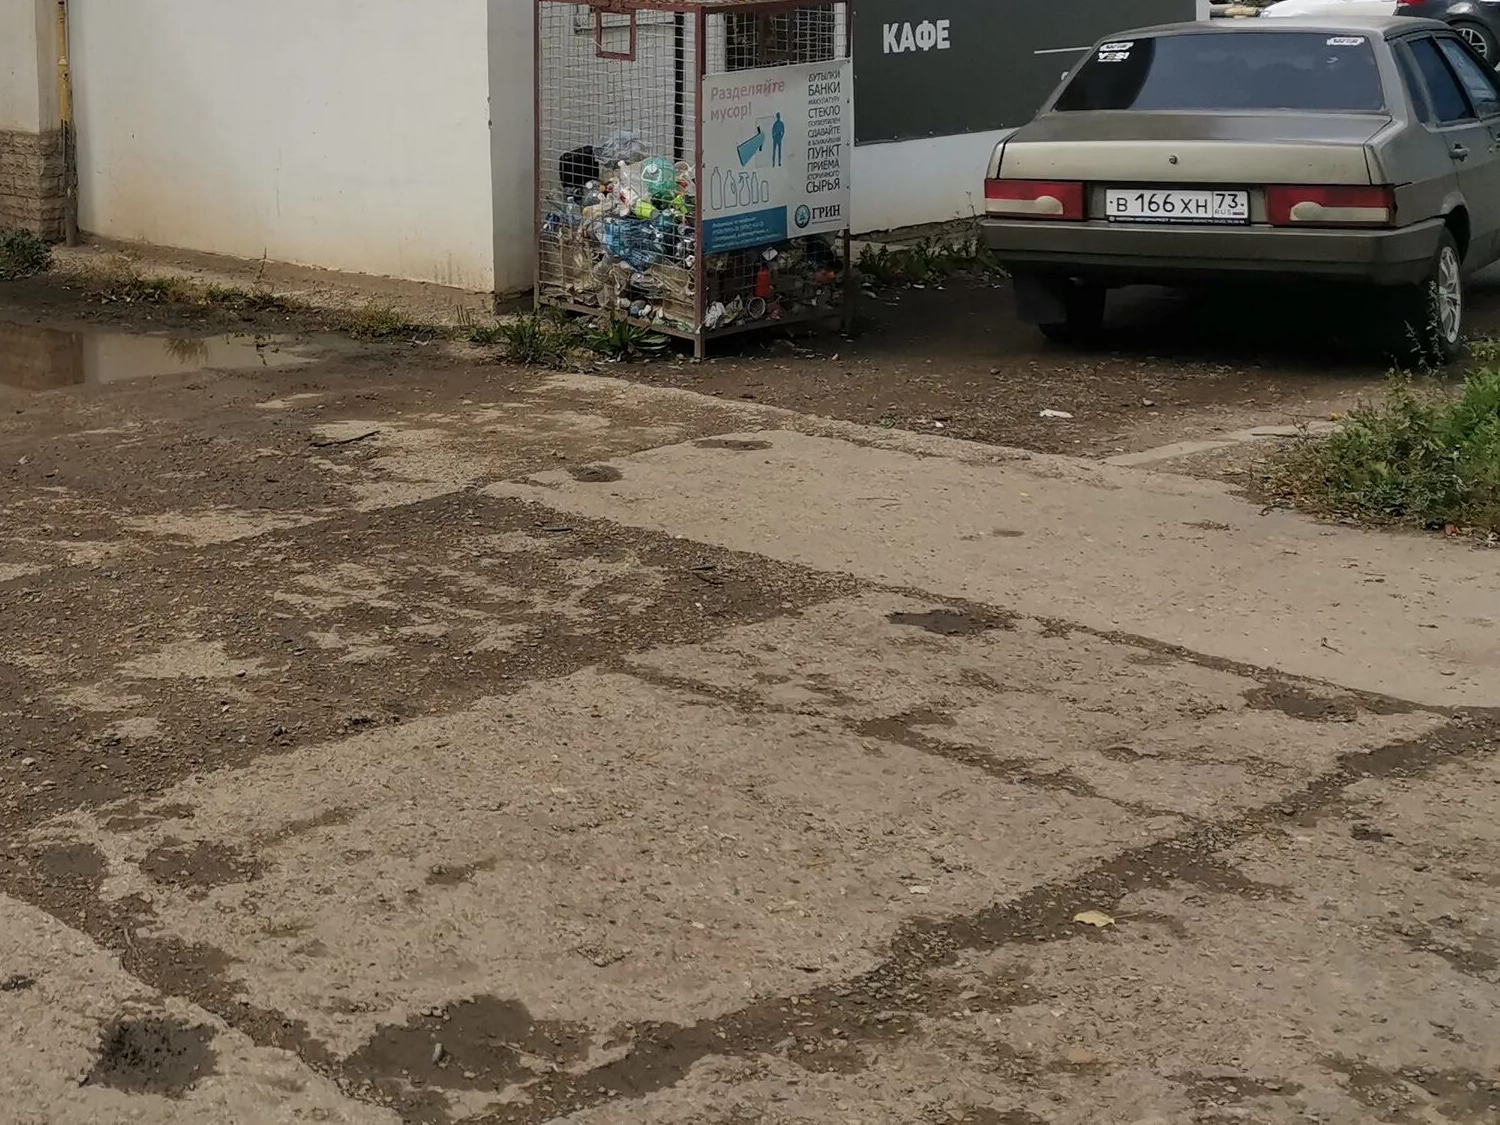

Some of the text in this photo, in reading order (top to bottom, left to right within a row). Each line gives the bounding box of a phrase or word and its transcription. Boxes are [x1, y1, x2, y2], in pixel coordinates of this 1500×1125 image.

[883, 19, 951, 54] КАФЕ
[808, 69, 840, 83] БУТЫЛКИ
[711, 78, 785, 101] Разделяйте
[808, 81, 840, 96] БАНКИ
[710, 102, 752, 124] мусор!
[808, 104, 841, 118] СТЕКЛО
[808, 125, 841, 137] СДАВАЙТЕ
[807, 143, 842, 161] ПУНКТ
[805, 177, 840, 194] СЫРЬЯ
[1214, 193, 1239, 209] 73
[811, 203, 841, 219] ГРИН
